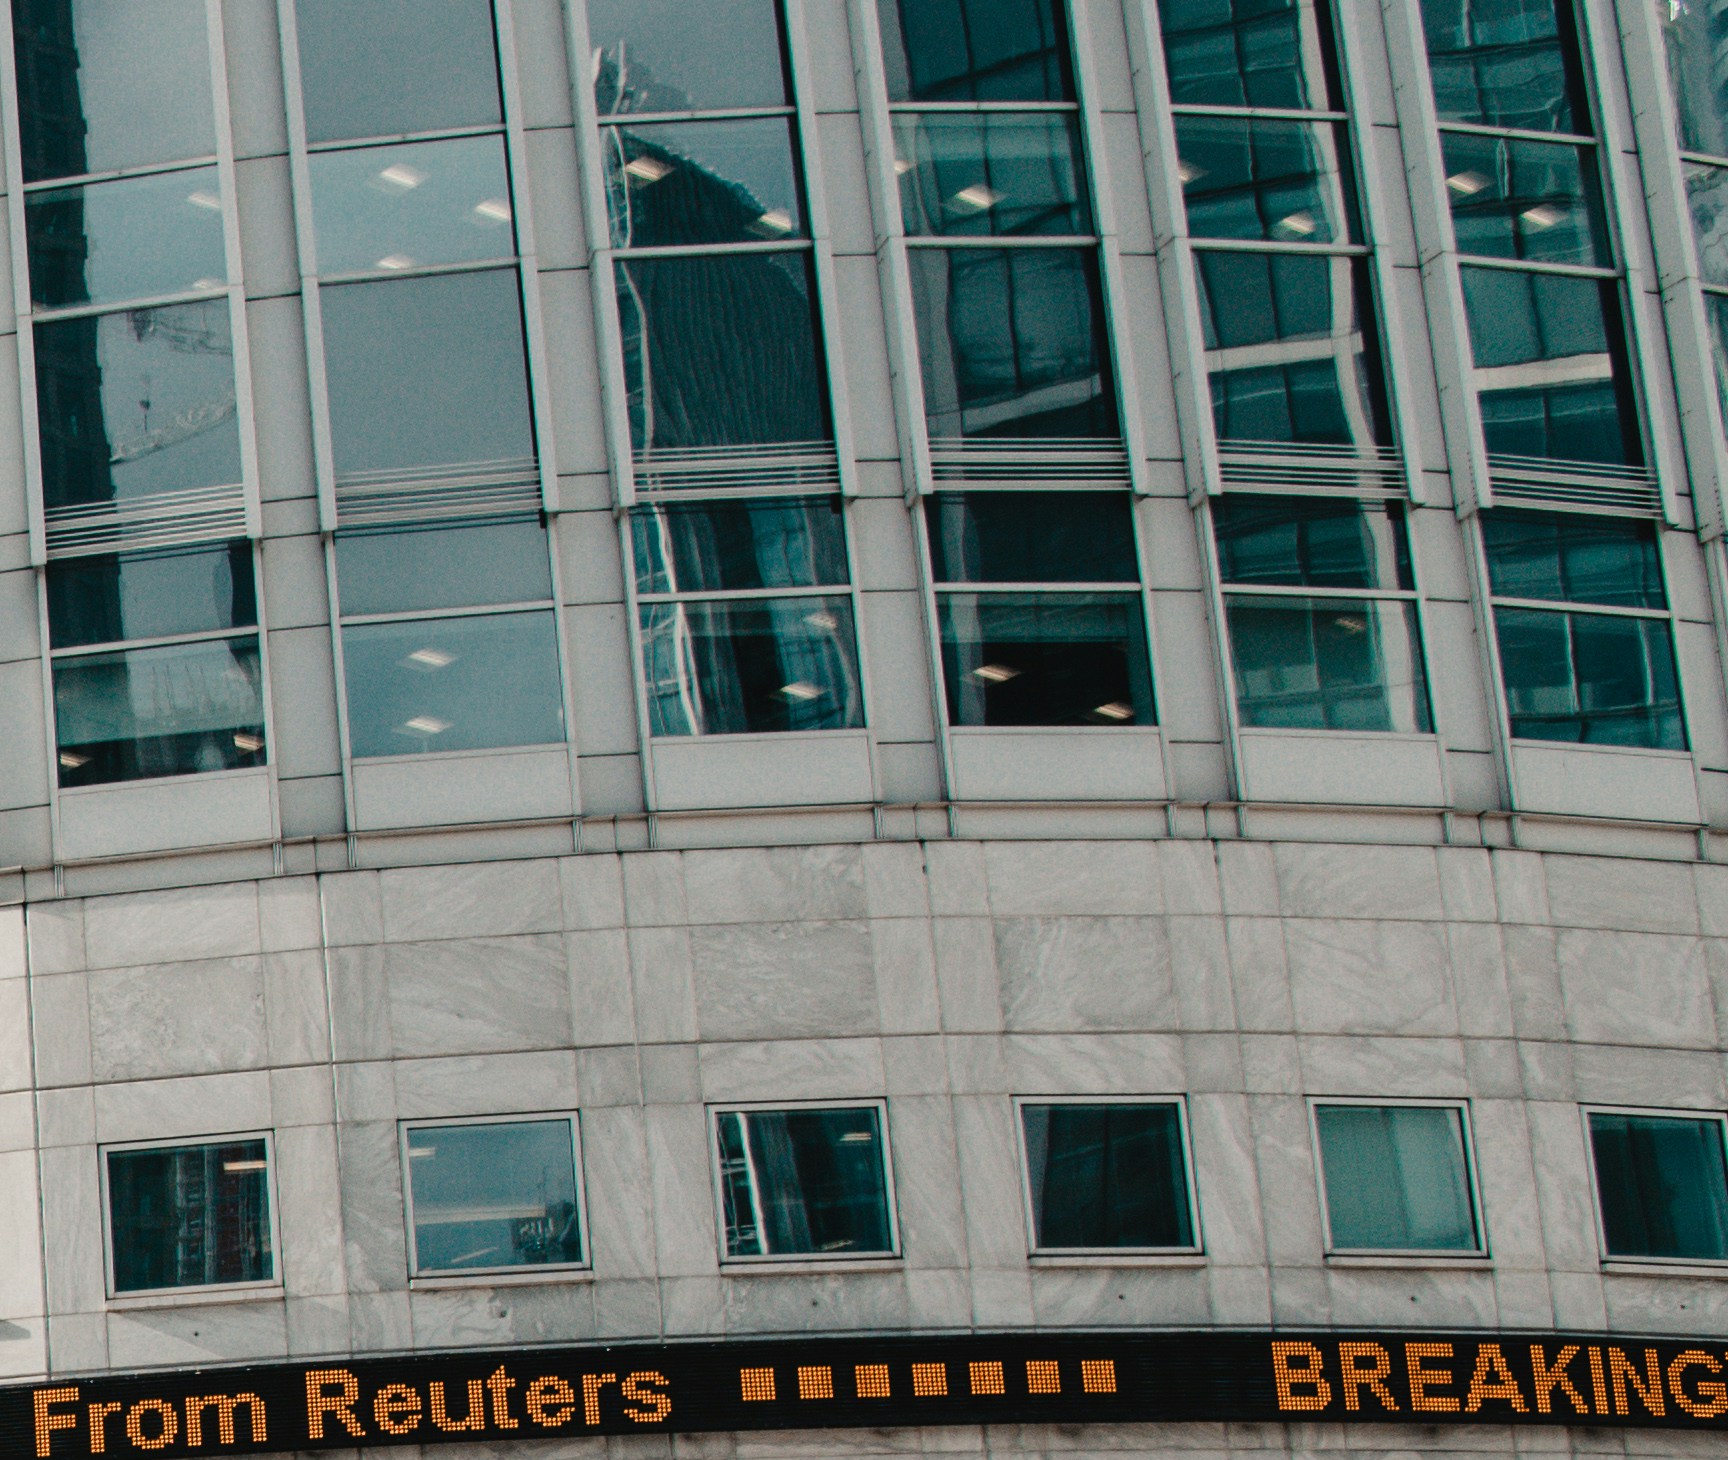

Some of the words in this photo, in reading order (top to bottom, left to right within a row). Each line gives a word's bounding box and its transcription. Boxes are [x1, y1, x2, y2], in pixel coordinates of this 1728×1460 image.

[33, 1387, 268, 1458] From
[305, 1365, 674, 1440] Reuters
[1271, 1341, 1728, 1420] BREAKING
